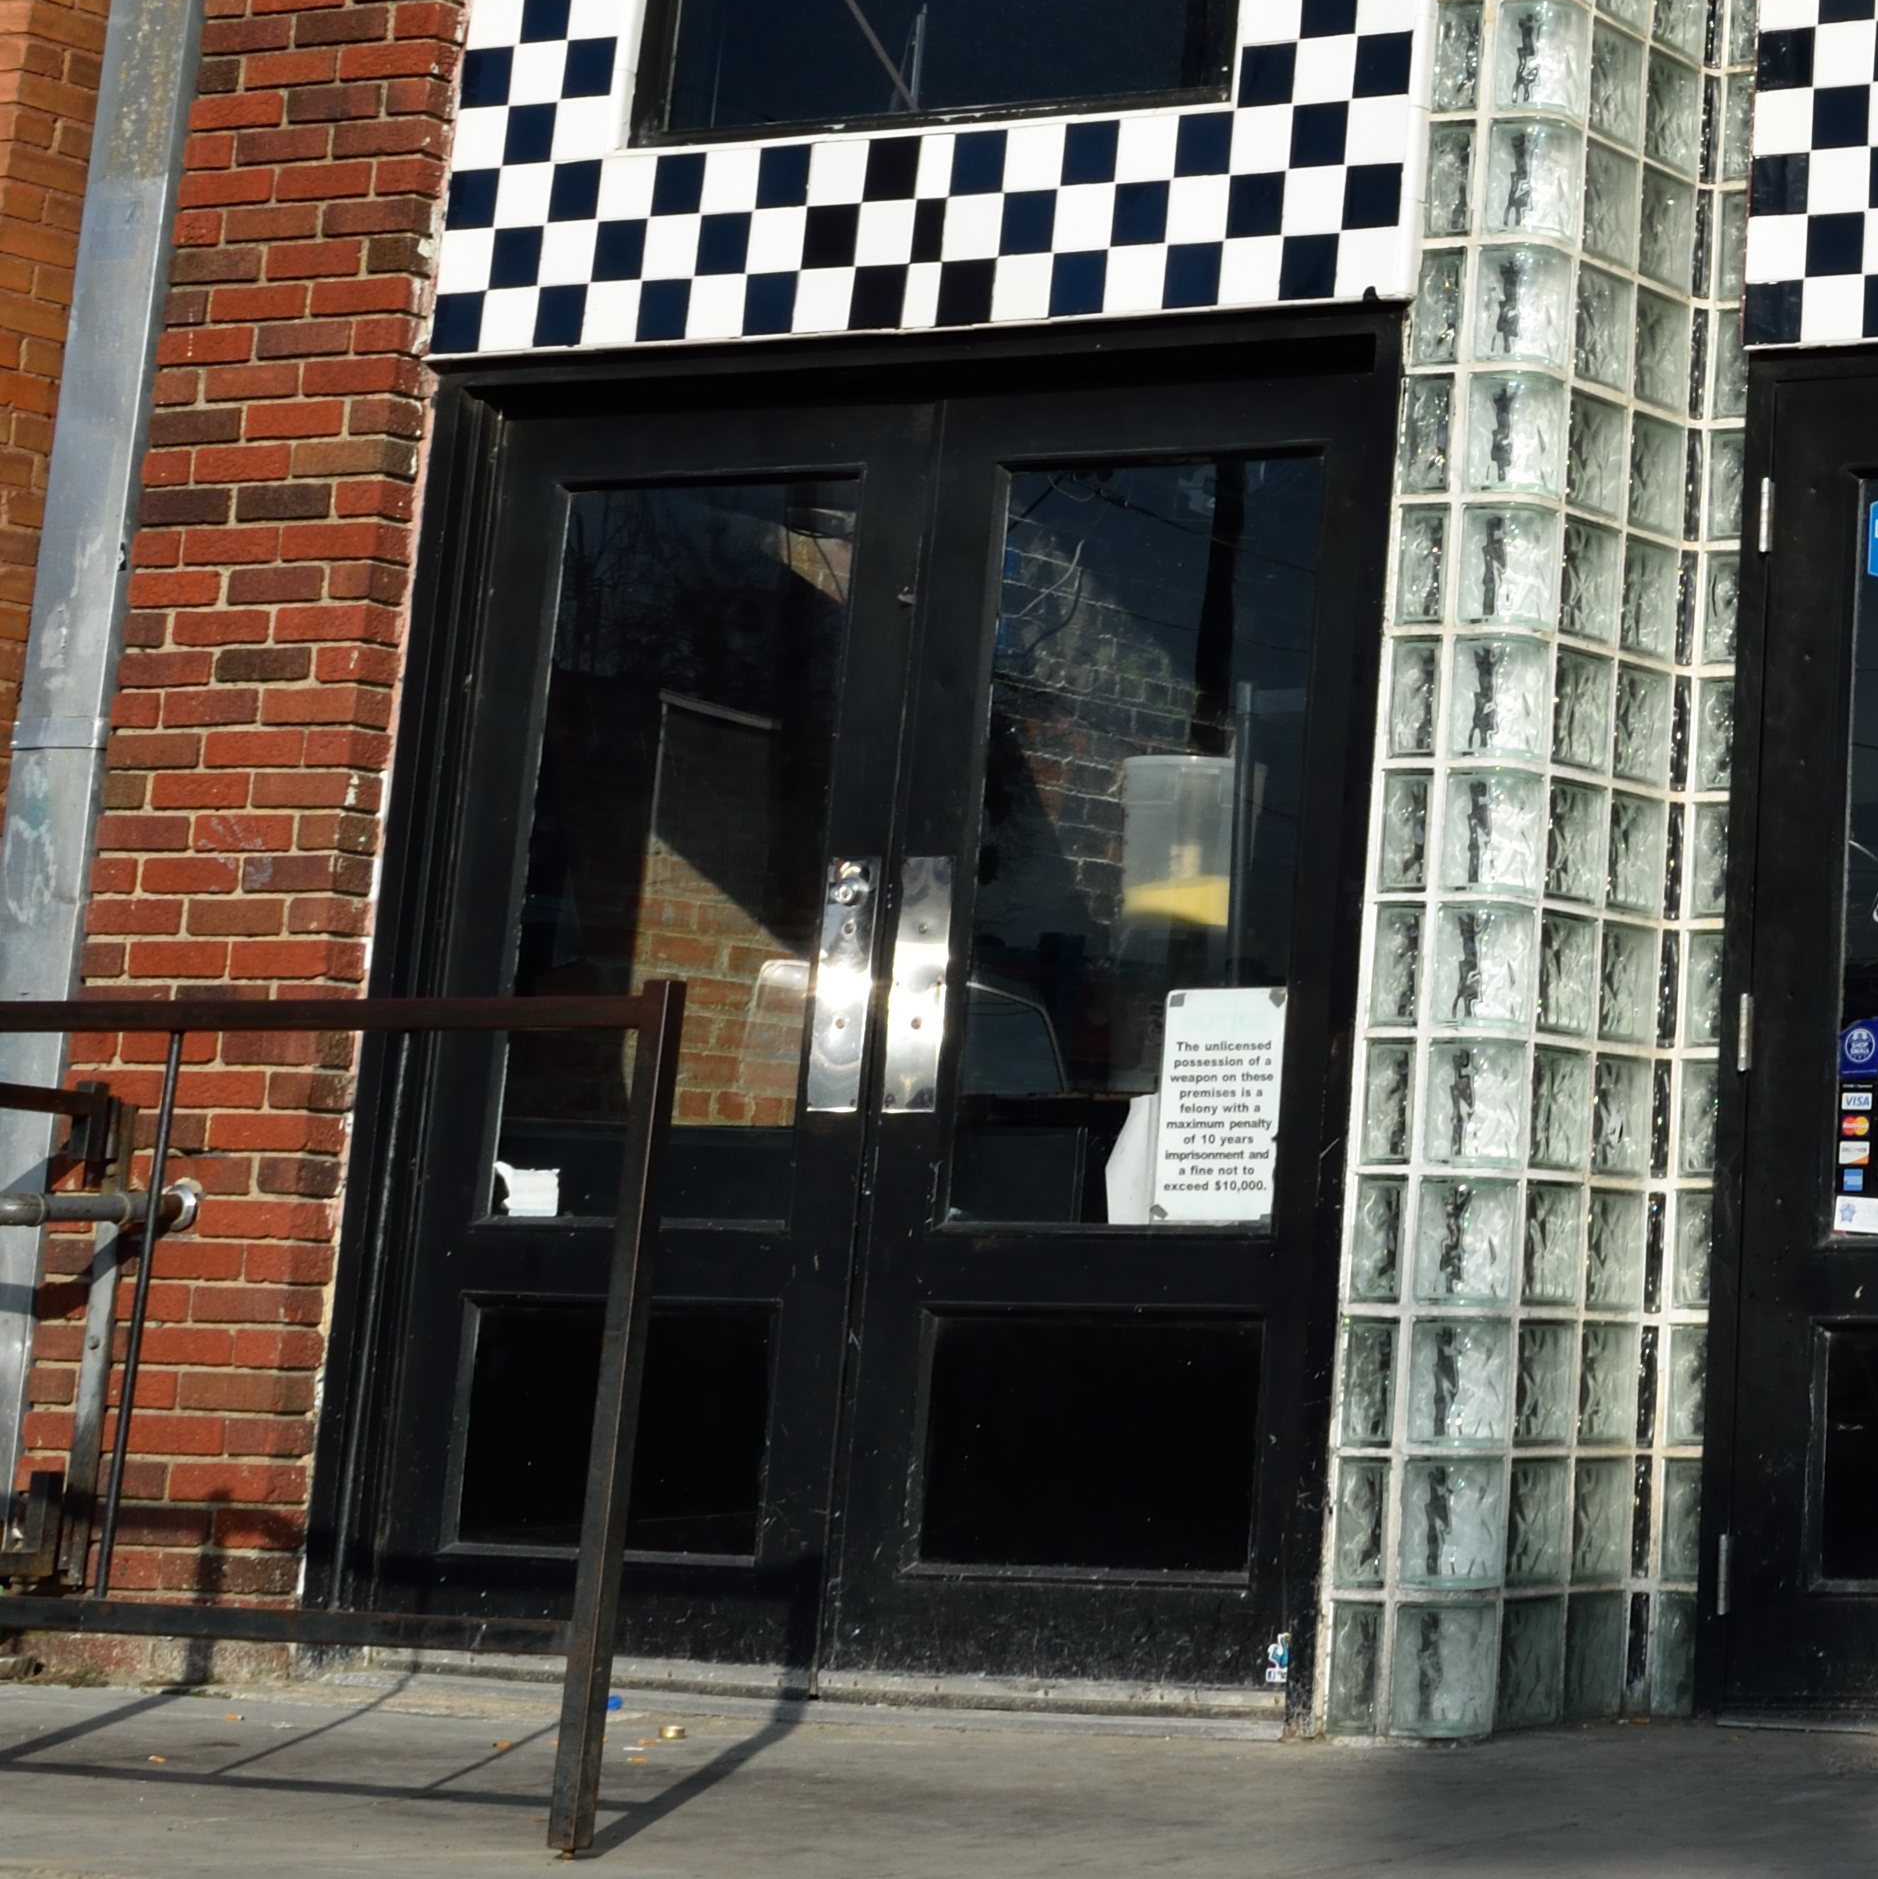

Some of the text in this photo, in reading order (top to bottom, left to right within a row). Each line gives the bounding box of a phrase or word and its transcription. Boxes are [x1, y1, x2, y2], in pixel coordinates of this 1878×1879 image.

[1177, 1041, 1271, 1052] The unlicensed
[1174, 1055, 1271, 1070] possession of a
[1170, 1071, 1273, 1086] weapon on these
[1179, 1088, 1236, 1100] premises
[1241, 1088, 1251, 1097] is
[1845, 1096, 1870, 1106] VISA
[1180, 1103, 1260, 1115] felony with a
[1166, 1119, 1271, 1131] maximum penalty
[1183, 1134, 1254, 1147] of 10 years
[1165, 1150, 1269, 1162] imprisonment and
[1179, 1166, 1255, 1176] a fine not to
[1164, 1180, 1267, 1193] exceed $10,000.
